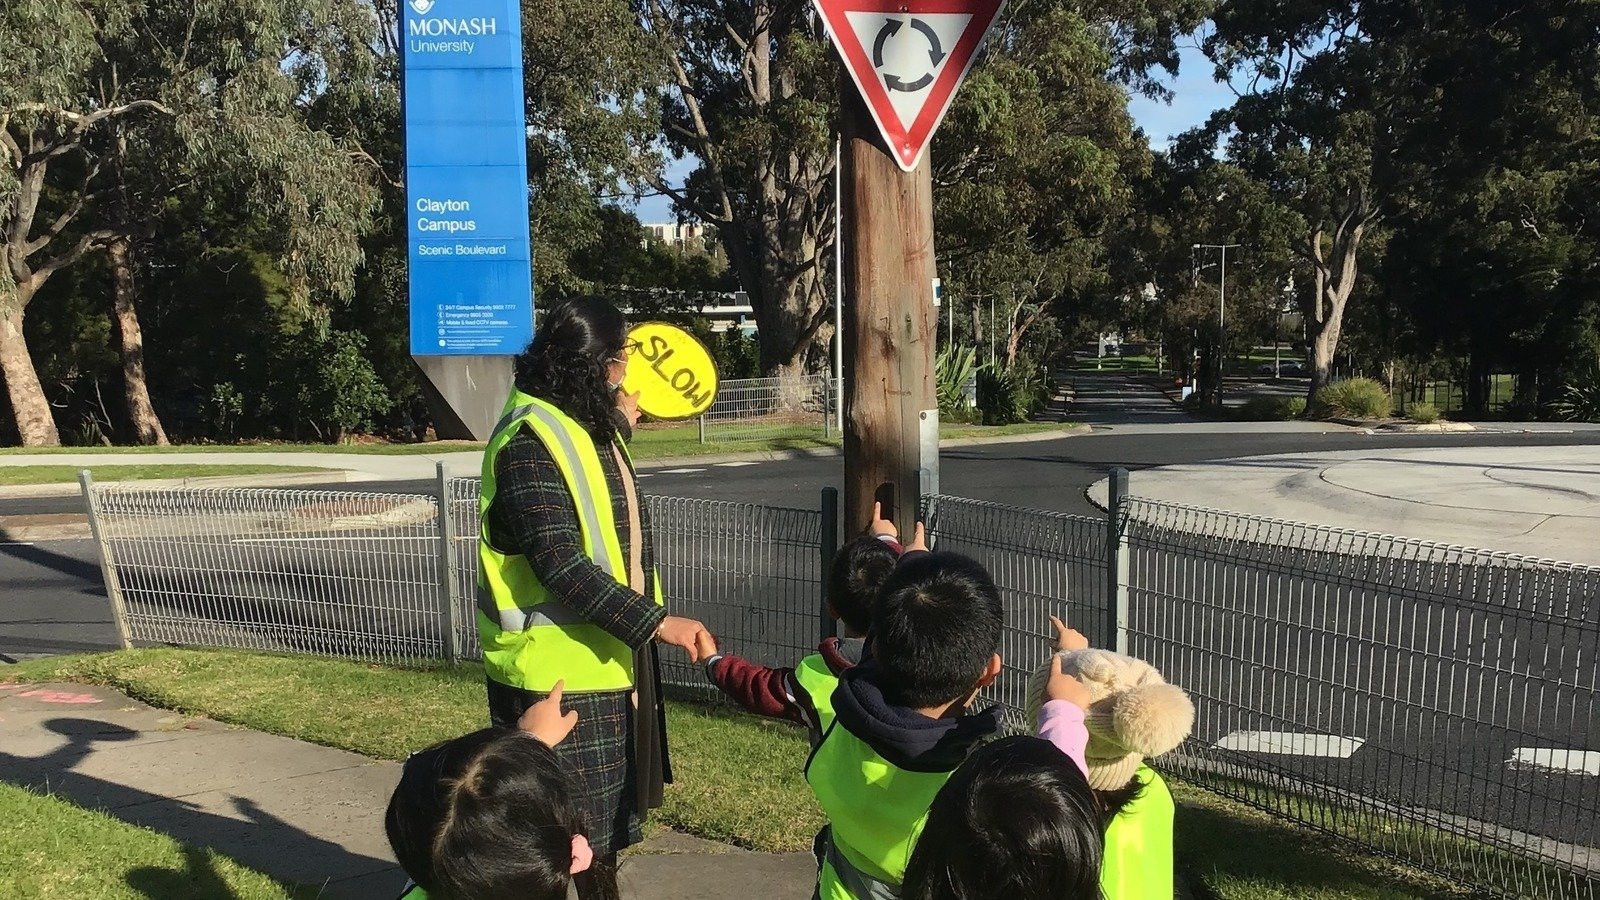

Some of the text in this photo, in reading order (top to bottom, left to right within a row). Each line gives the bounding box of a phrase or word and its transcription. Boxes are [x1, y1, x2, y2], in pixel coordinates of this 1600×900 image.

[409, 18, 496, 36] MONASH
[410, 39, 475, 54] University
[416, 198, 470, 214] Clayton
[417, 217, 476, 233] Campus
[418, 244, 506, 255] Scenic Boulevard
[636, 335, 711, 408] SLOW
